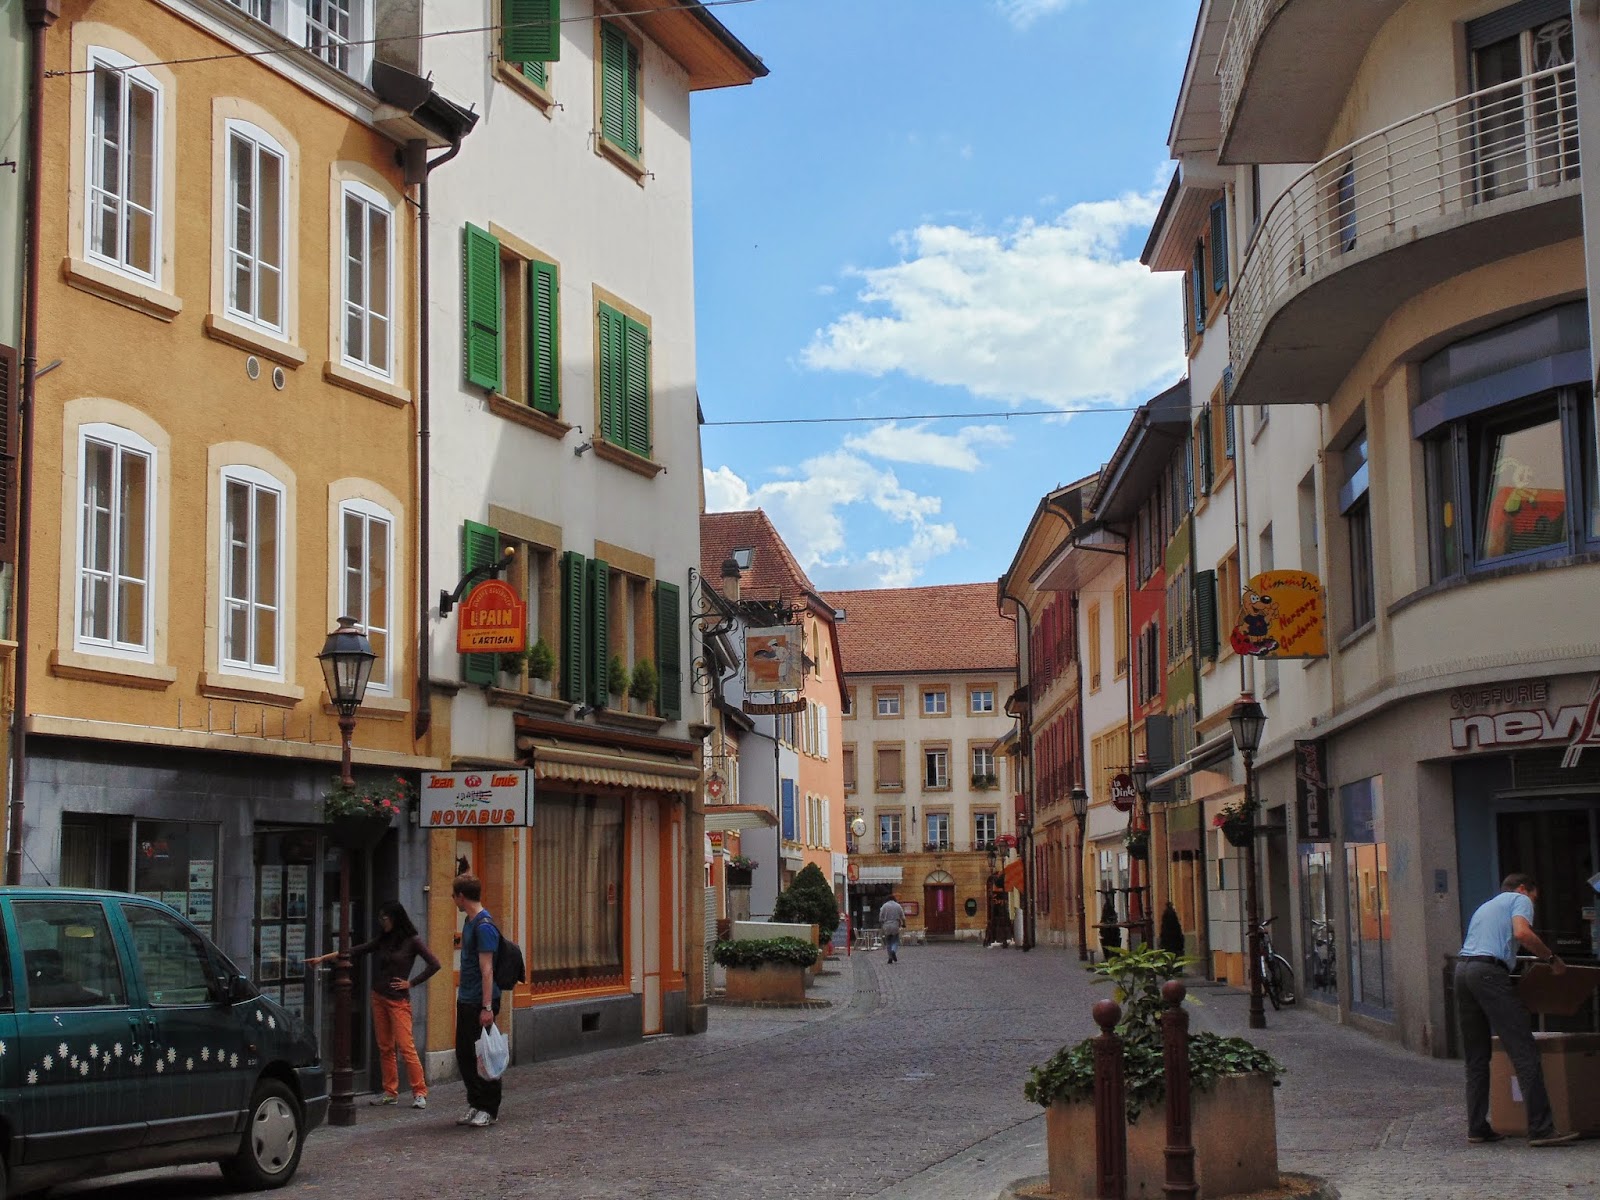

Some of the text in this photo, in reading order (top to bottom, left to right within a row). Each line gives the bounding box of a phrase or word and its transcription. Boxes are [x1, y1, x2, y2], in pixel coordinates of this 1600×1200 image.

[1450, 683, 1547, 710] COIFFURE
[744, 698, 806, 714] BOULANGERE
[427, 773, 519, 789] Jean Louis
[430, 808, 515, 826] NOVABUS
